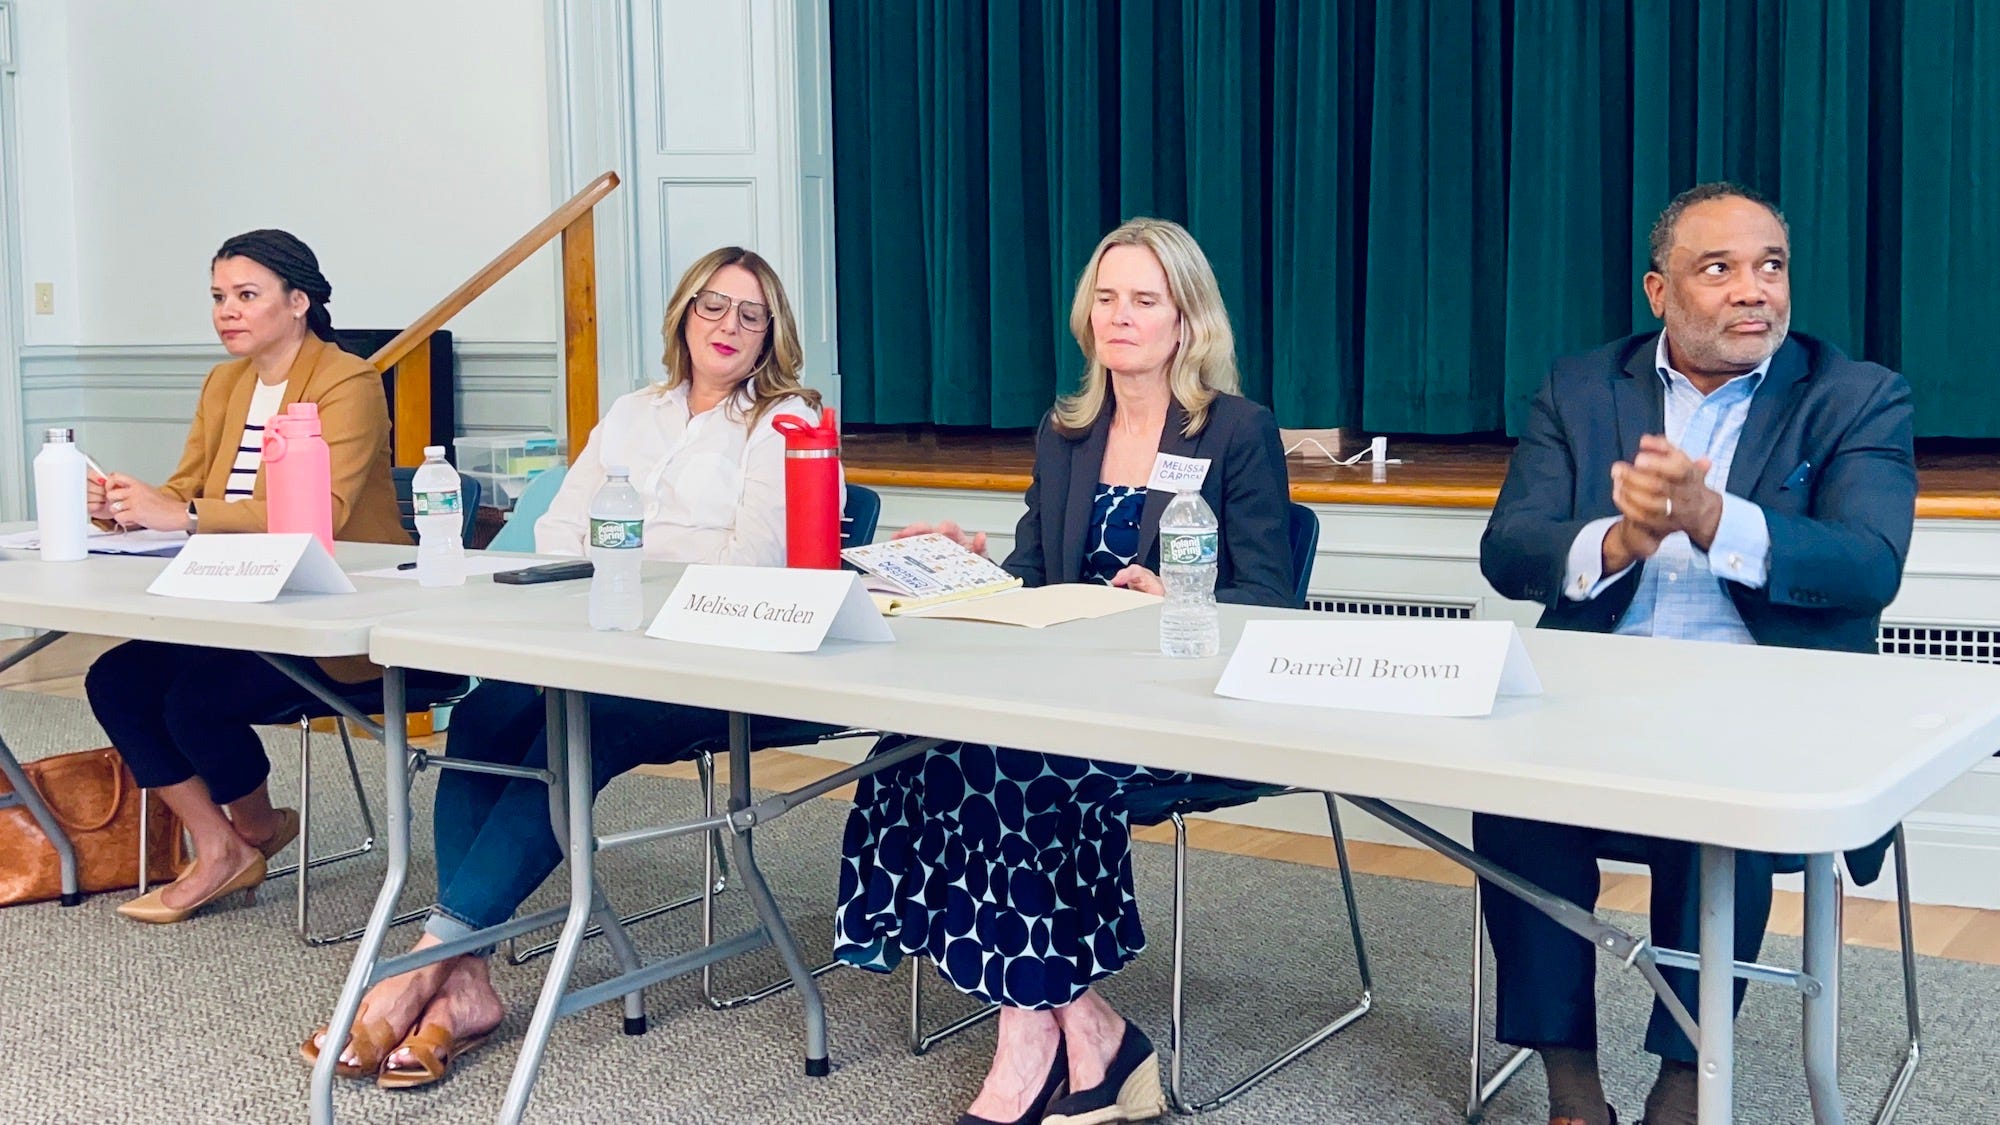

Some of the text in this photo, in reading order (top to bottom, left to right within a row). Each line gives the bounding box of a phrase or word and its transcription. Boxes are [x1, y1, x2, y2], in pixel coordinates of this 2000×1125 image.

[1163, 460, 1205, 473] MELISSA
[184, 559, 281, 576] Bernice Morris
[683, 593, 815, 624] Melissa Carden
[1268, 657, 1460, 679] Darrèll Brown
